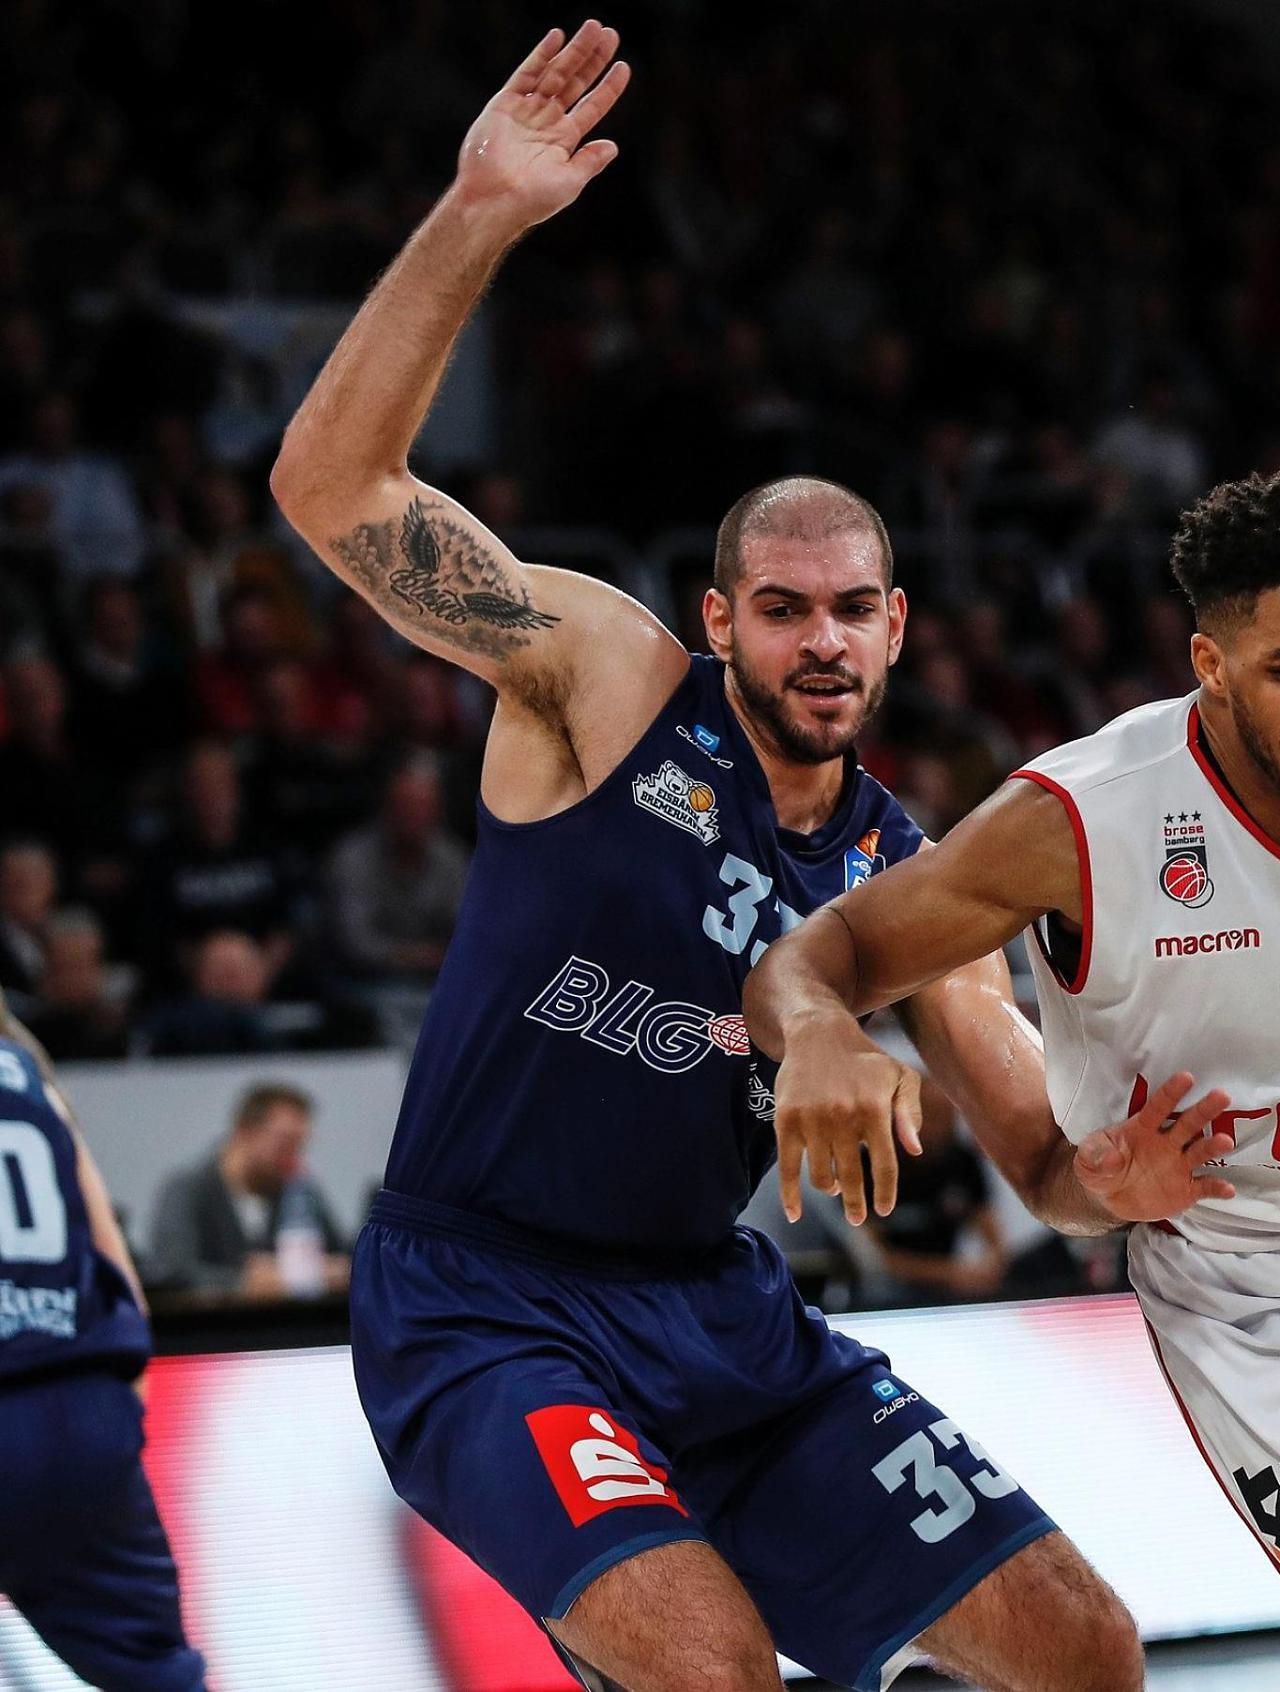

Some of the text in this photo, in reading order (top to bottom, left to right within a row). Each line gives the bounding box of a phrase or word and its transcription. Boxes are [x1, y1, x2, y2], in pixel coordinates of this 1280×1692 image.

[1164, 825, 1204, 836] brose
[1165, 836, 1205, 846] bamberg
[1156, 928, 1260, 957] macron
[524, 955, 715, 1073] BLG
[873, 1392, 919, 1424] owayo
[871, 1418, 1020, 1543] 33
